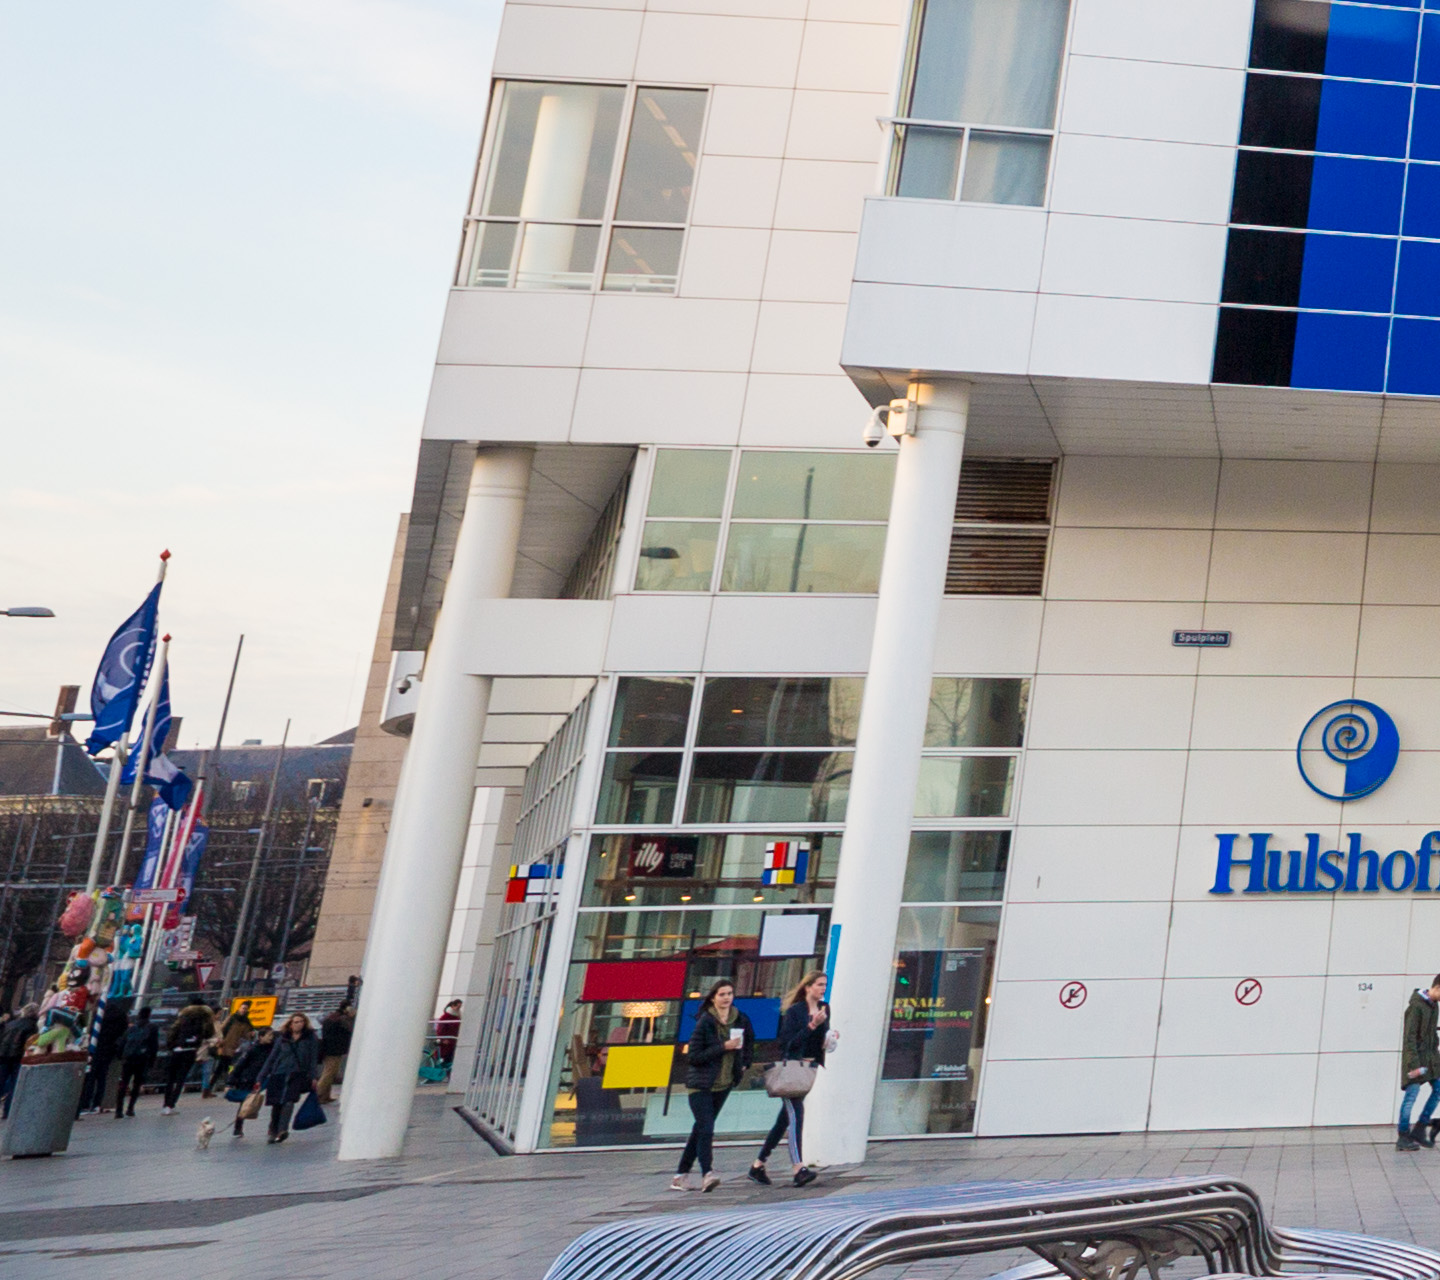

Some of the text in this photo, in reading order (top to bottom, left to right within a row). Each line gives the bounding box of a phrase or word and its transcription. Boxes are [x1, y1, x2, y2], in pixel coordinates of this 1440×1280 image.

[634, 842, 665, 873] illy
[1358, 983, 1373, 991] 134
[894, 997, 946, 1008] FINALE
[959, 1010, 974, 1020] op
